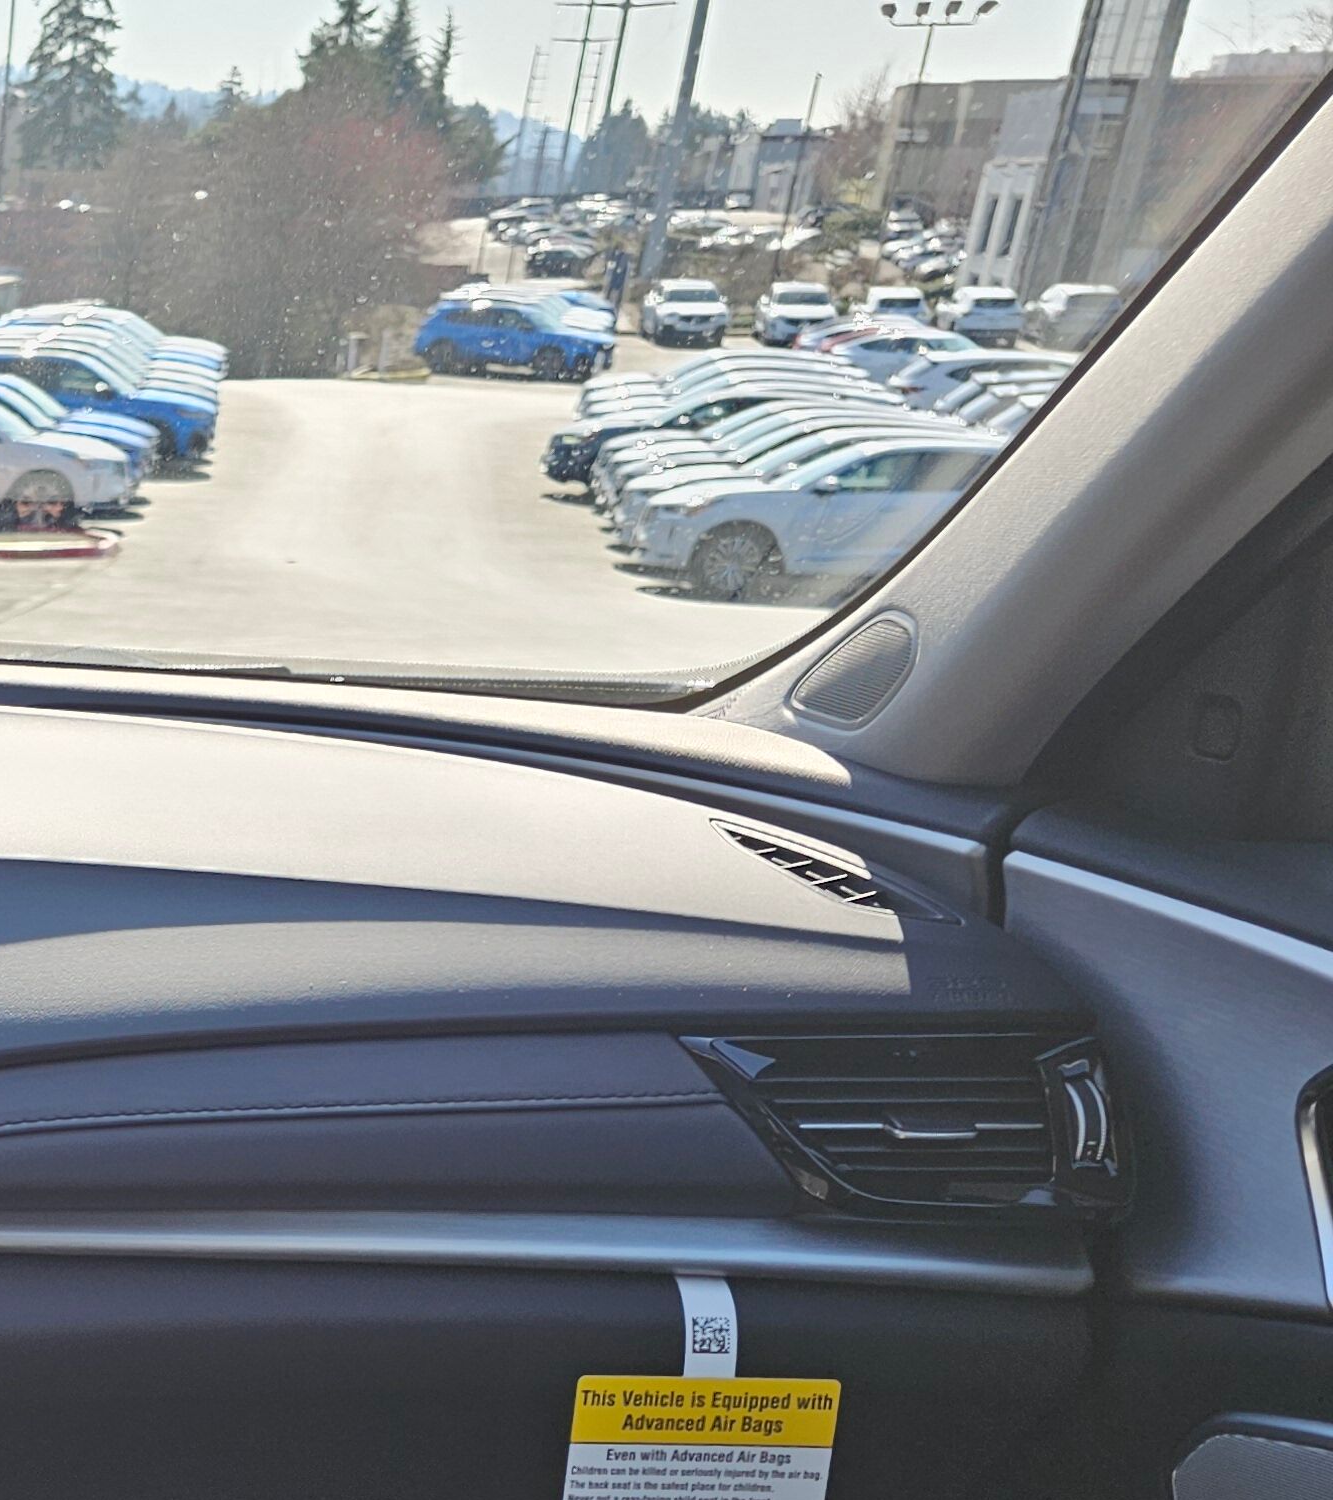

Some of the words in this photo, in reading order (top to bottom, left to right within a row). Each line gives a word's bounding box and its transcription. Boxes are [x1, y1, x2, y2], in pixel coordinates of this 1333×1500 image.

[581, 1389, 616, 1407] This
[622, 1390, 685, 1408] Vehicle
[691, 1391, 706, 1409] is
[711, 1391, 792, 1412] Equipped
[796, 1393, 834, 1410] with
[621, 1413, 706, 1432] Advanced
[710, 1415, 737, 1432] Air
[740, 1416, 784, 1436] Bags
[606, 1448, 636, 1461] Even
[640, 1449, 667, 1461] with
[670, 1450, 734, 1463] Advanced
[736, 1450, 757, 1463] Air
[759, 1451, 792, 1466] Bags
[571, 1465, 608, 1475] Children
[641, 1467, 667, 1476] killed
[771, 1470, 786, 1478] the
[570, 1480, 585, 1489] The
[588, 1481, 609, 1489] back
[691, 1483, 716, 1492] place
[718, 1483, 731, 1491] for
